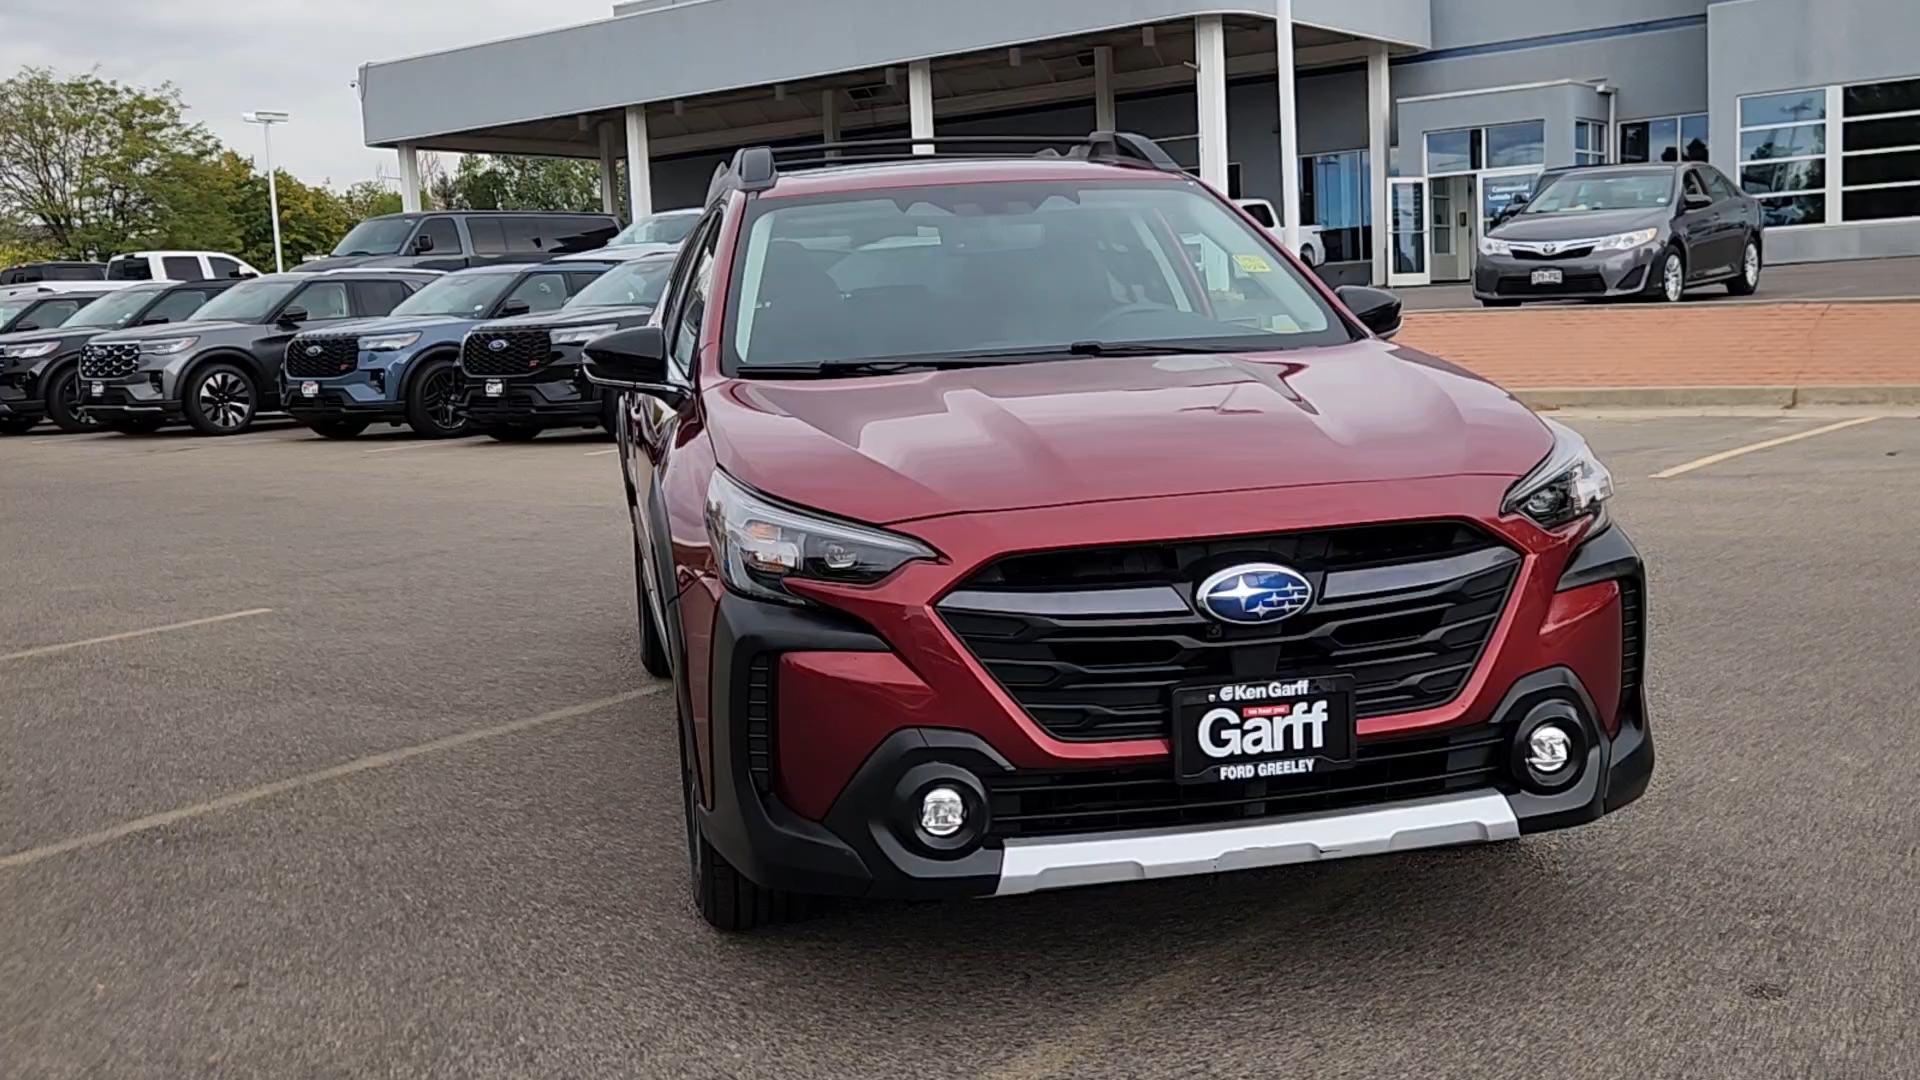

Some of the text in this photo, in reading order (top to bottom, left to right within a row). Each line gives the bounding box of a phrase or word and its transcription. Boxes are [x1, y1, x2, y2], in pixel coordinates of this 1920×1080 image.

[1268, 679, 1309, 698] Garff
[1198, 700, 1328, 758] Garff
[1220, 759, 1315, 780] FORD GREELEY
